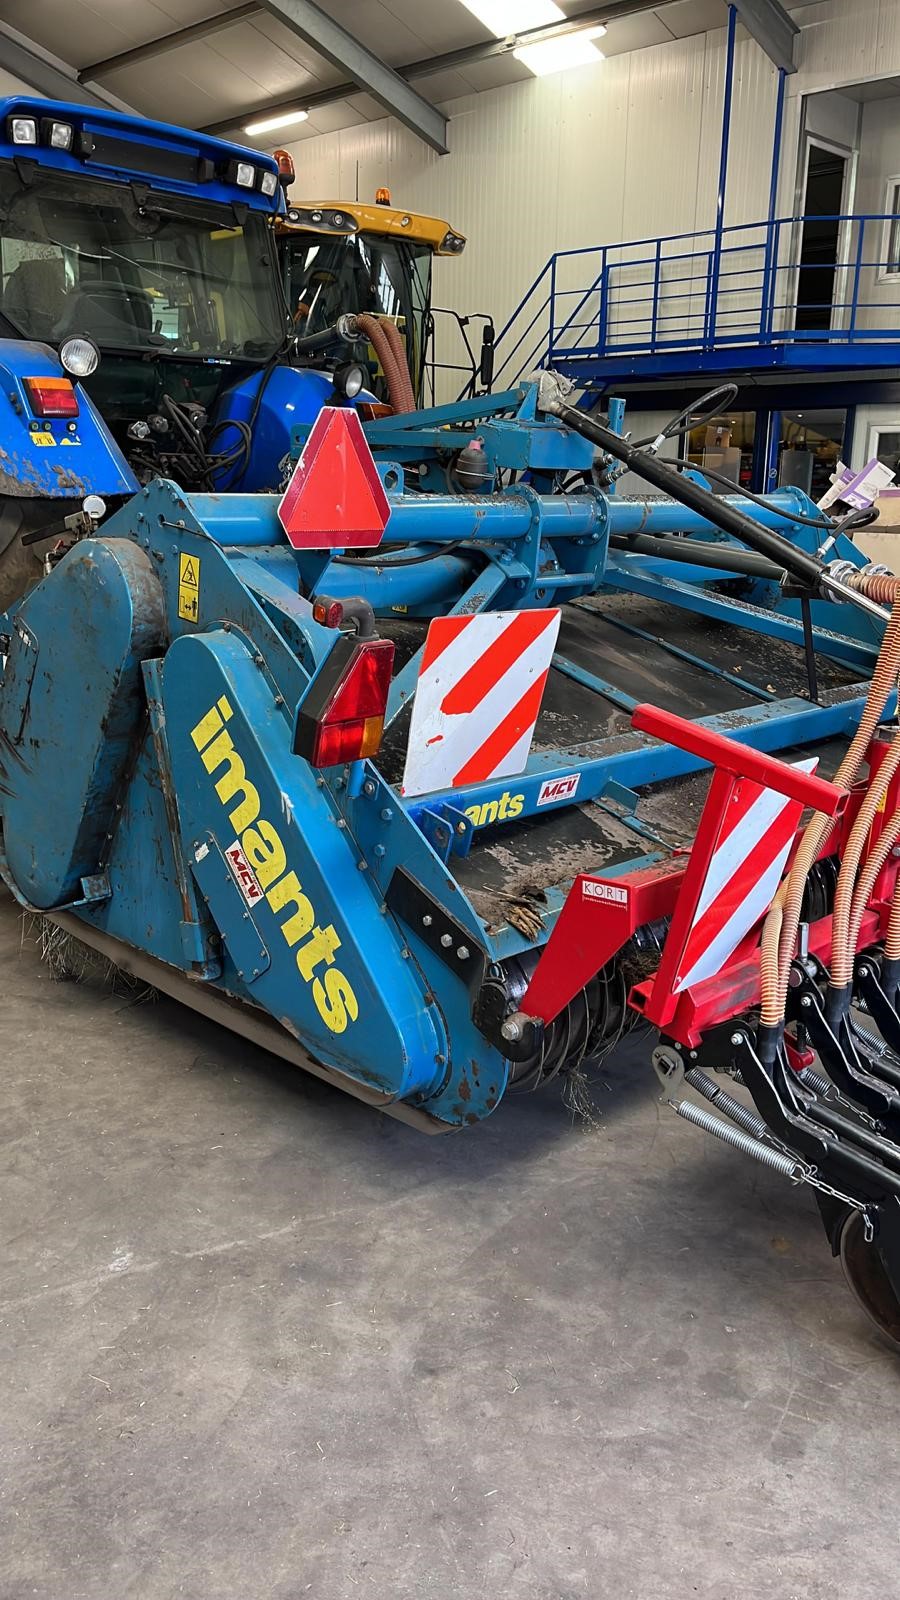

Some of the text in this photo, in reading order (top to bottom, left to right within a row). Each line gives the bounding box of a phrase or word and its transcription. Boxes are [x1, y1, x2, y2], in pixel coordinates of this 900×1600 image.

[540, 779, 578, 799] MCV
[189, 694, 360, 1035] imants
[229, 849, 260, 898] MCV
[584, 882, 625, 901] KORT
